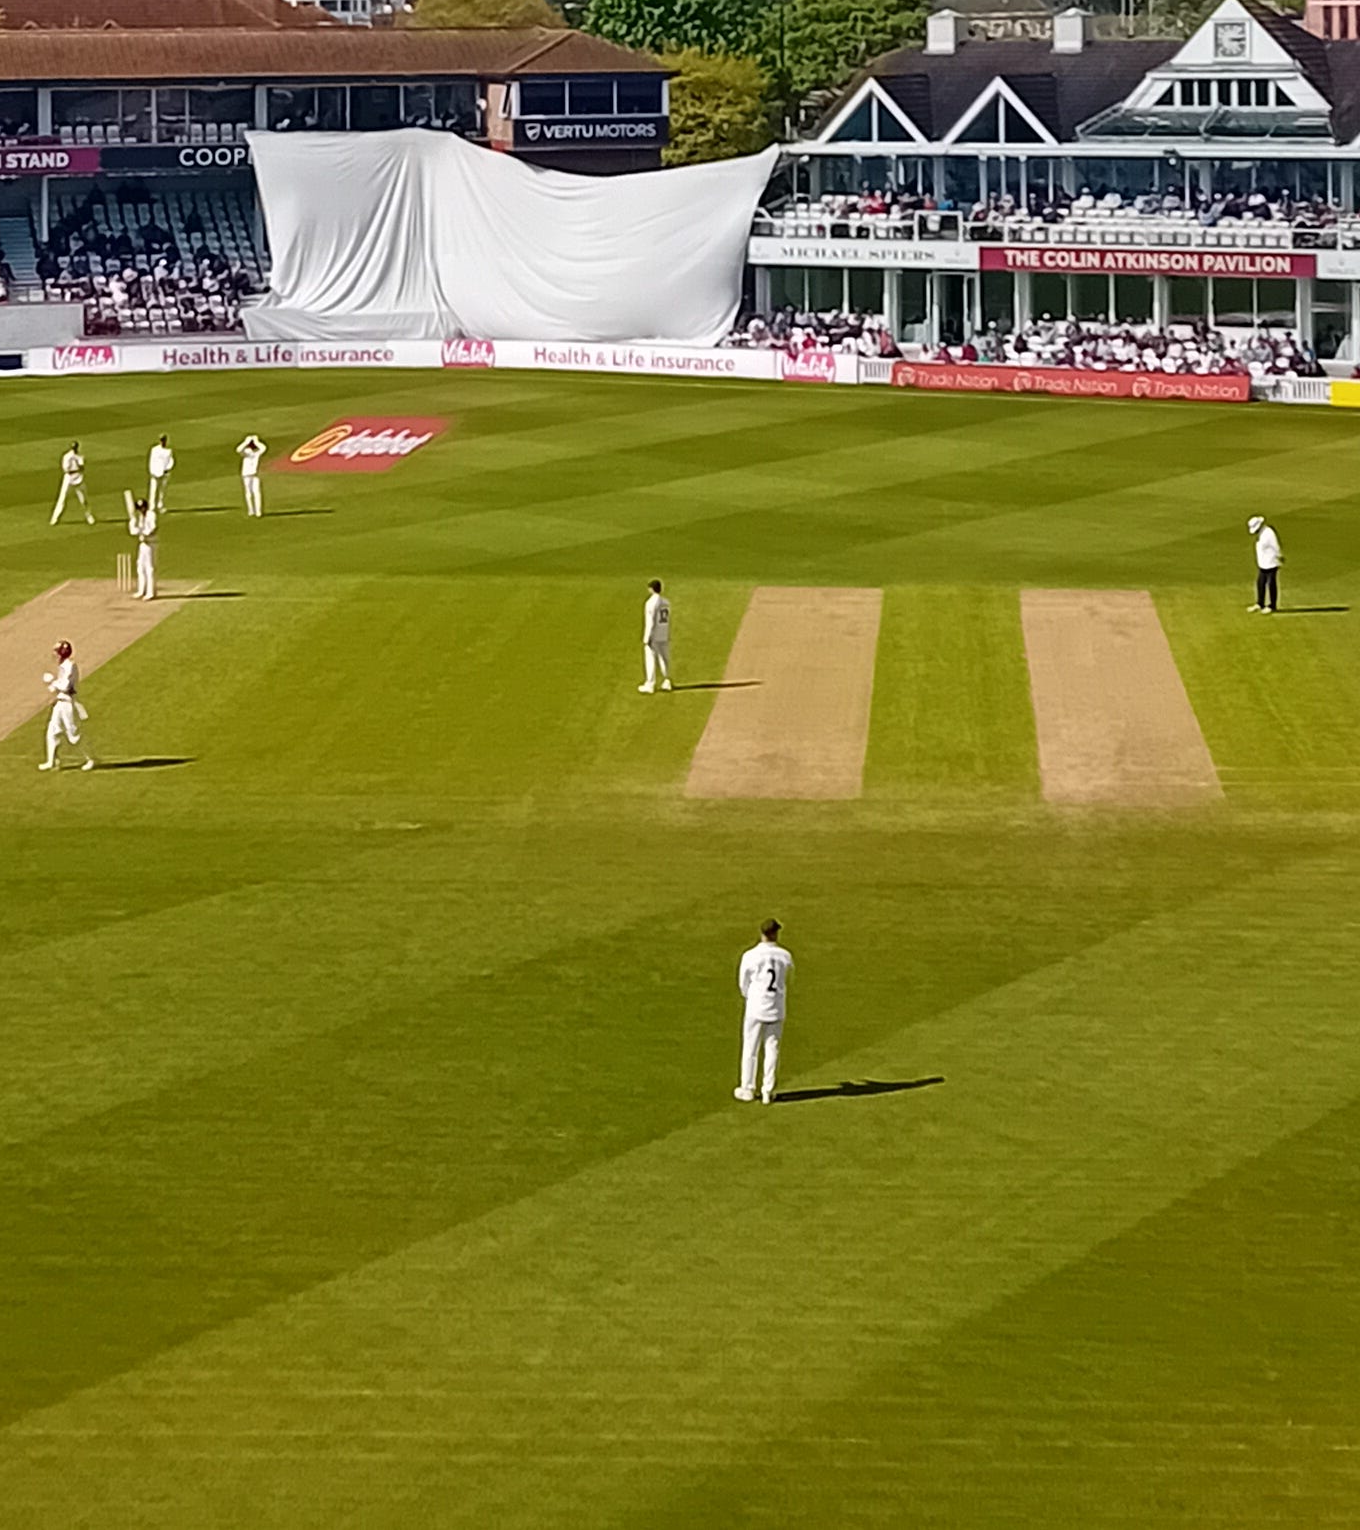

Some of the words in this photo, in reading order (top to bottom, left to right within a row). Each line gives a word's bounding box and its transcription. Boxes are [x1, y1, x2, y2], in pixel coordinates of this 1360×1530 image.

[543, 124, 593, 138] VERTU
[595, 123, 656, 137] MOTORS
[5, 152, 70, 168] STAND
[781, 246, 862, 261] MICHAEL
[869, 250, 936, 262] SPIERS
[1004, 249, 1040, 267] THE
[1043, 250, 1100, 269] COLIN
[1103, 252, 1199, 271] ATKINSON
[1202, 254, 1291, 274] PAVILION
[163, 344, 229, 365] Health
[236, 348, 248, 363] &
[255, 344, 293, 363] Life
[300, 346, 394, 363] insurance
[444, 340, 493, 368] Vitality
[534, 347, 590, 366] Health
[596, 351, 606, 366] &
[612, 350, 646, 368] Life
[651, 353, 735, 372] insurance
[918, 371, 953, 386] Trade
[956, 373, 999, 388] Nation
[1034, 376, 1071, 391] Trade
[1074, 378, 1117, 393] Nation
[1155, 381, 1191, 397] Trade
[1194, 384, 1240, 398] Nation
[767, 969, 777, 992] 2
